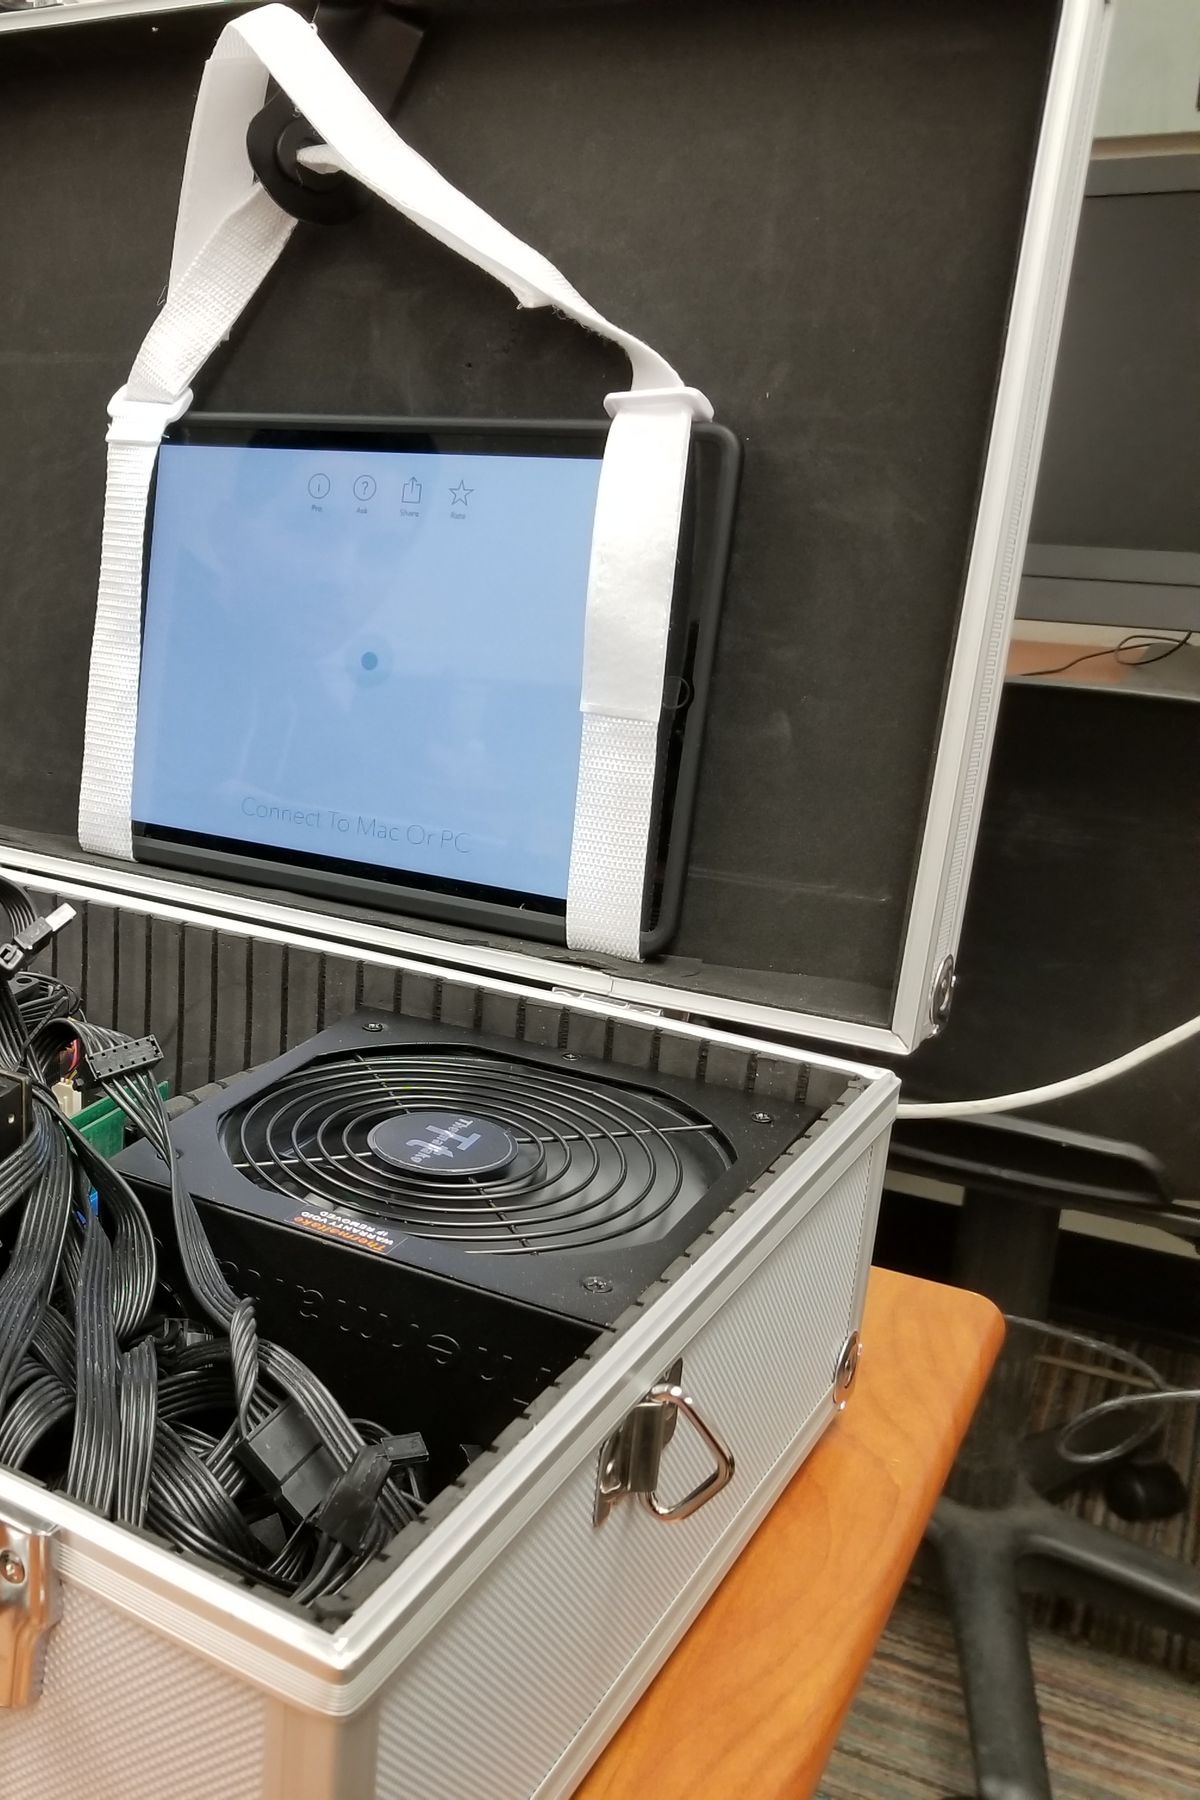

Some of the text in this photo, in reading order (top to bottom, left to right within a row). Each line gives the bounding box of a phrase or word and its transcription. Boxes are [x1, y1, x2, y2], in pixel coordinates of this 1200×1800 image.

[400, 508, 420, 517] Share
[241, 797, 472, 853] Connect To Mac Or PC
[294, 1216, 386, 1252] Thermaltake
[301, 1211, 394, 1245] WARRANTY VOID
[320, 1210, 376, 1232] REMOVED
